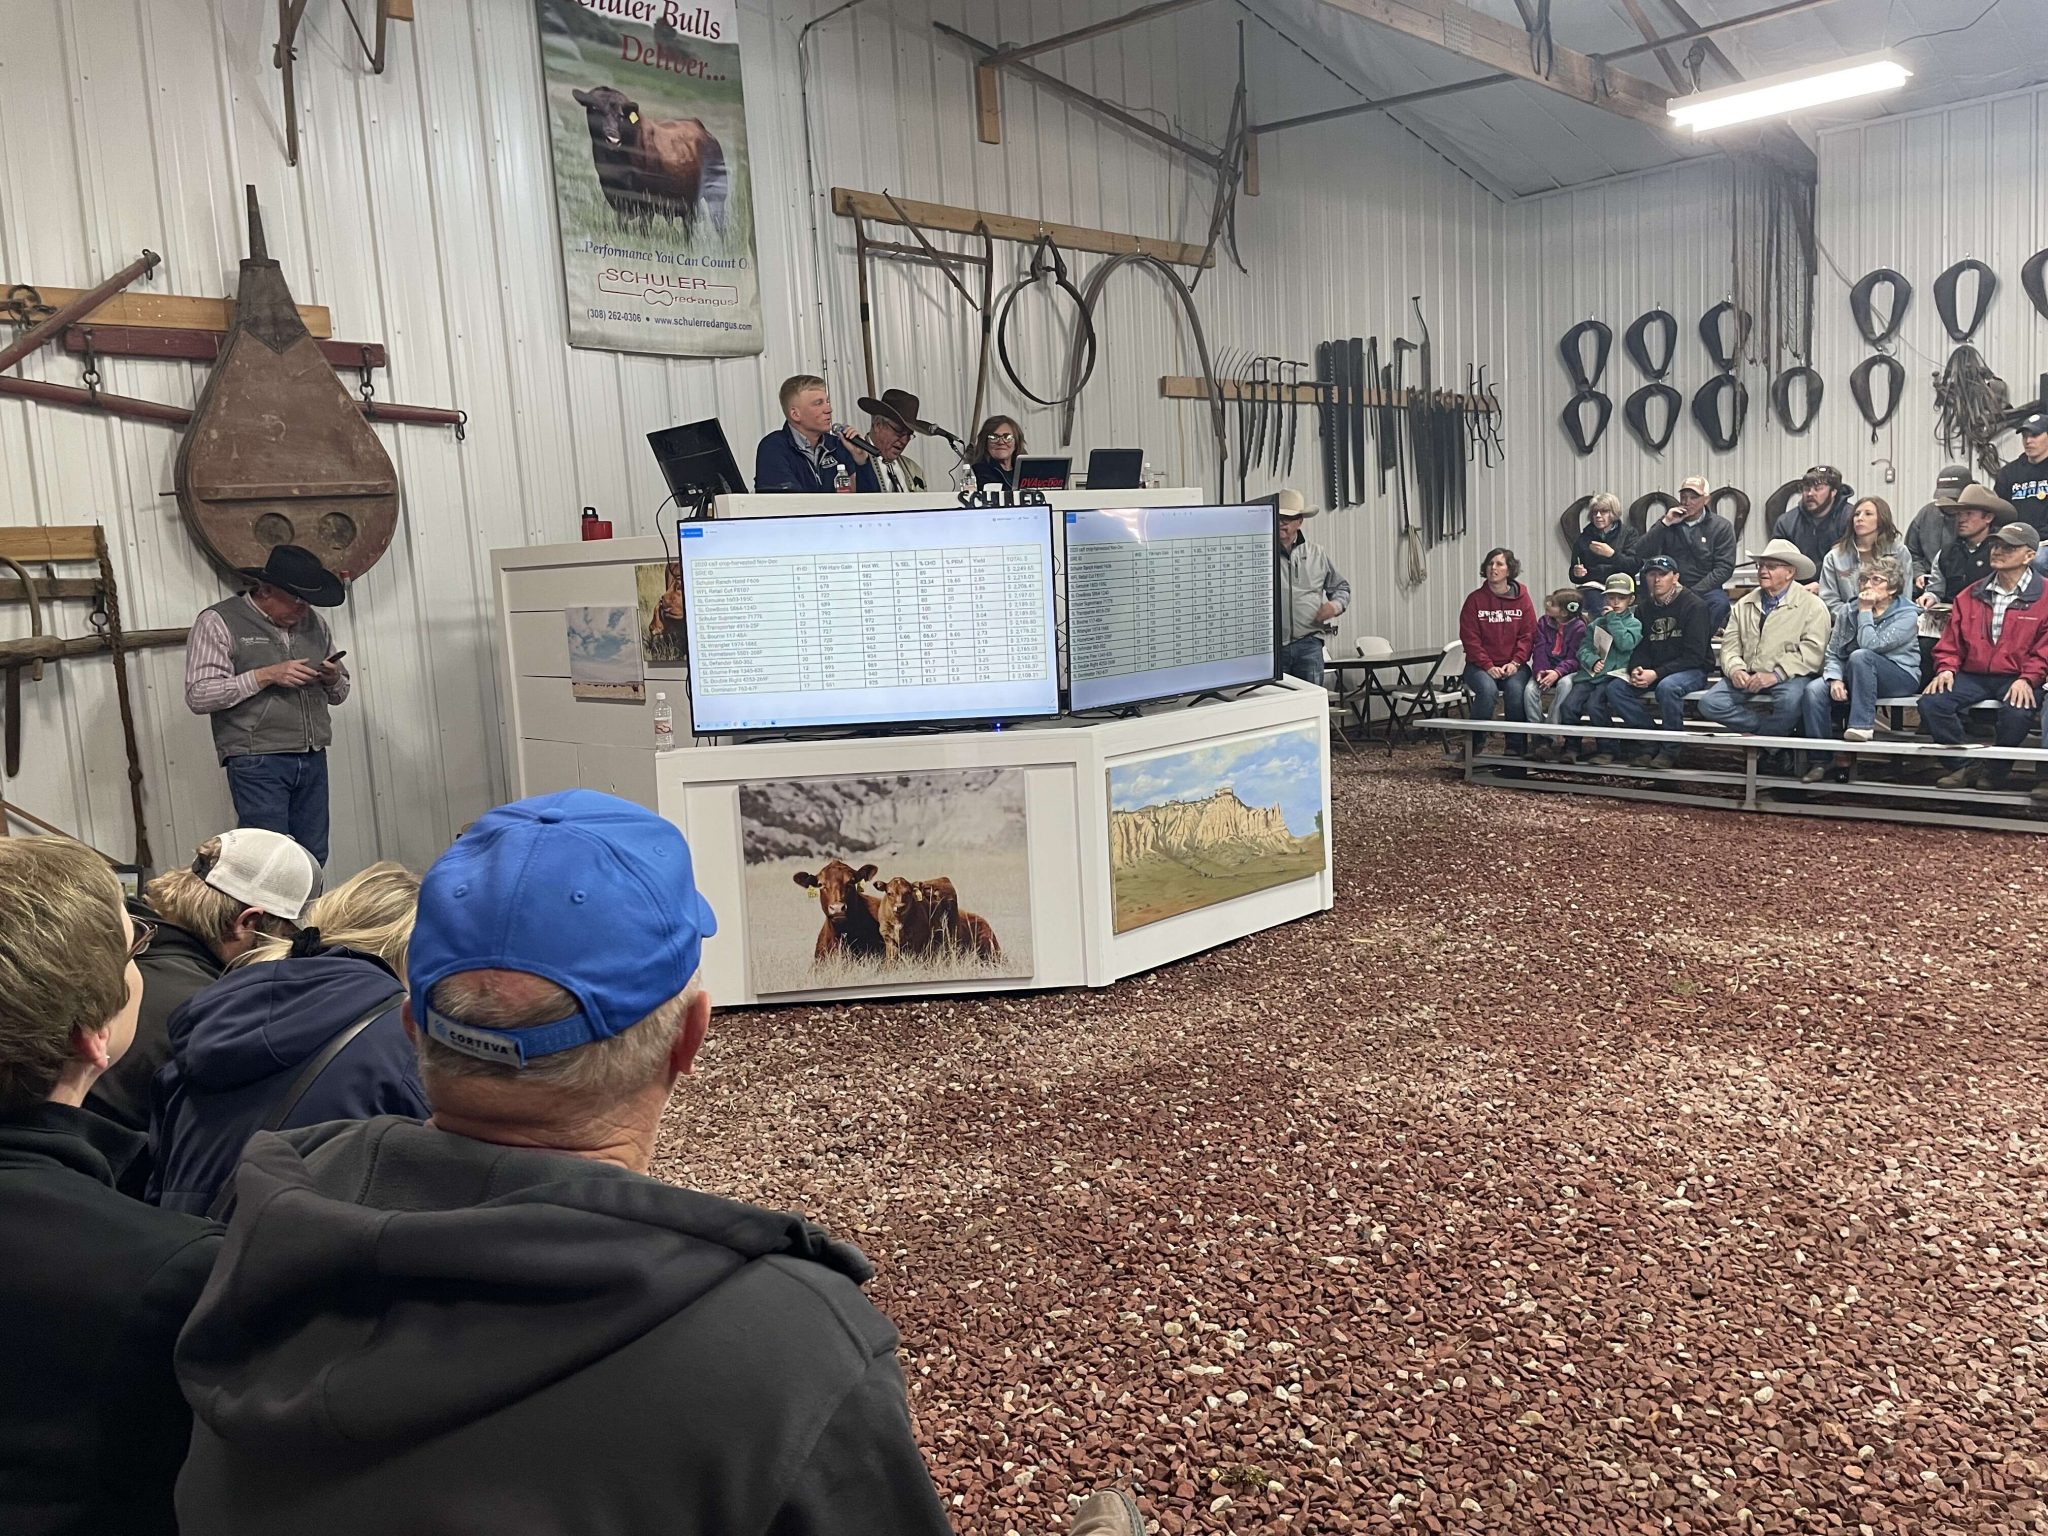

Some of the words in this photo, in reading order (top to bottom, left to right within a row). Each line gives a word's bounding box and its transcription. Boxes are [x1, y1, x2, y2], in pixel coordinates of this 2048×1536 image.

[578, 0, 655, 21] uler
[663, 0, 720, 39] Bulls
[620, 33, 725, 81] Deliver...
[575, 241, 653, 261] ...Performance
[656, 251, 674, 264] You
[676, 254, 698, 266] Can
[702, 256, 736, 269] Count
[739, 258, 750, 270] O
[606, 268, 707, 290] SCHULER
[587, 308, 606, 320] (308)
[608, 311, 642, 322] 262-0306
[654, 316, 752, 330] www.schulerredangus.com
[449, 1030, 508, 1054] CORTEVA
